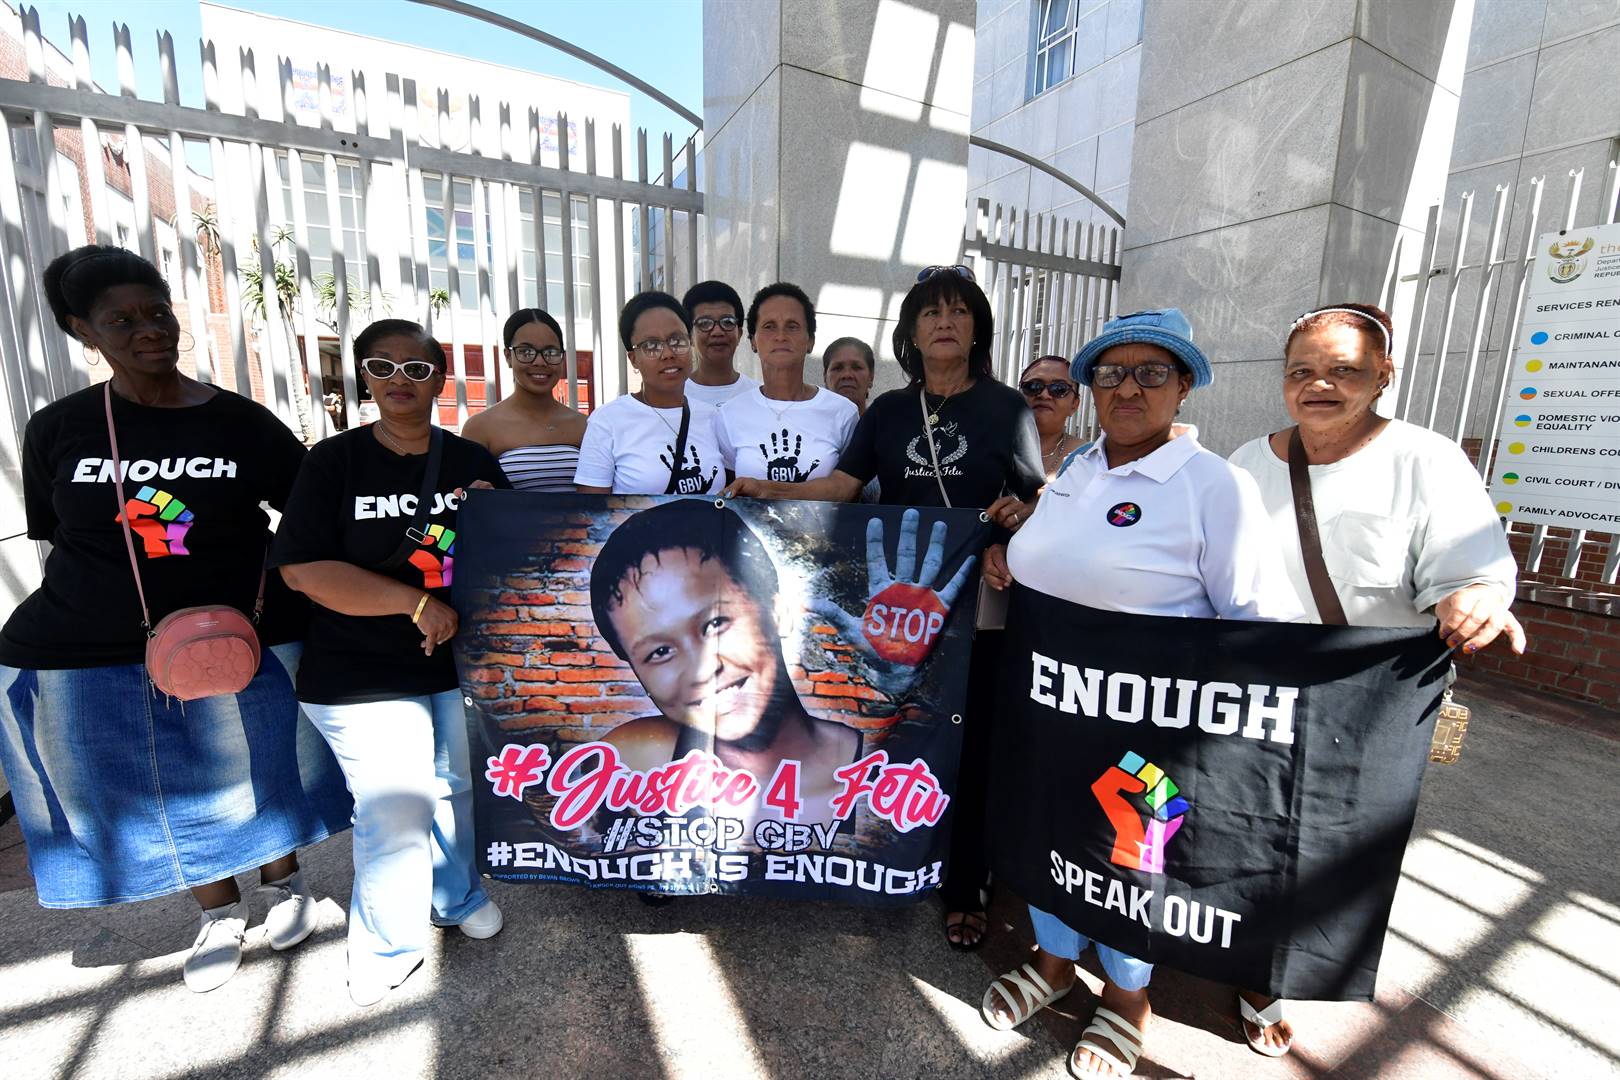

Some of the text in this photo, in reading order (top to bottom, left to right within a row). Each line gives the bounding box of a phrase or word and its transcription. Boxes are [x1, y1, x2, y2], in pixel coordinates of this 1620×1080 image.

[1536, 301, 1593, 313] SERVICES
[1554, 331, 1610, 341] CRIMINAL
[1543, 390, 1588, 398] SEXUAL
[1538, 414, 1597, 422] DOMESTIC
[1536, 423, 1593, 431] EQUALITY
[1531, 445, 1596, 456] CHILDRENS
[71, 456, 238, 483] ENOUGH
[771, 467, 796, 482] GBV
[678, 476, 702, 494] GBV
[1525, 476, 1551, 485] CIVIL
[1554, 478, 1595, 488] COURT
[1518, 505, 1557, 516] FAMILY
[867, 603, 945, 645] STOP
[1030, 651, 1299, 744] ENOUGH
[763, 759, 803, 822] 4
[829, 750, 950, 833] Fetu
[604, 816, 844, 852] #STOP GBV
[487, 841, 942, 894] #ENOUGH IS ENOUGH
[1050, 850, 1242, 949] SPEAK OUT
